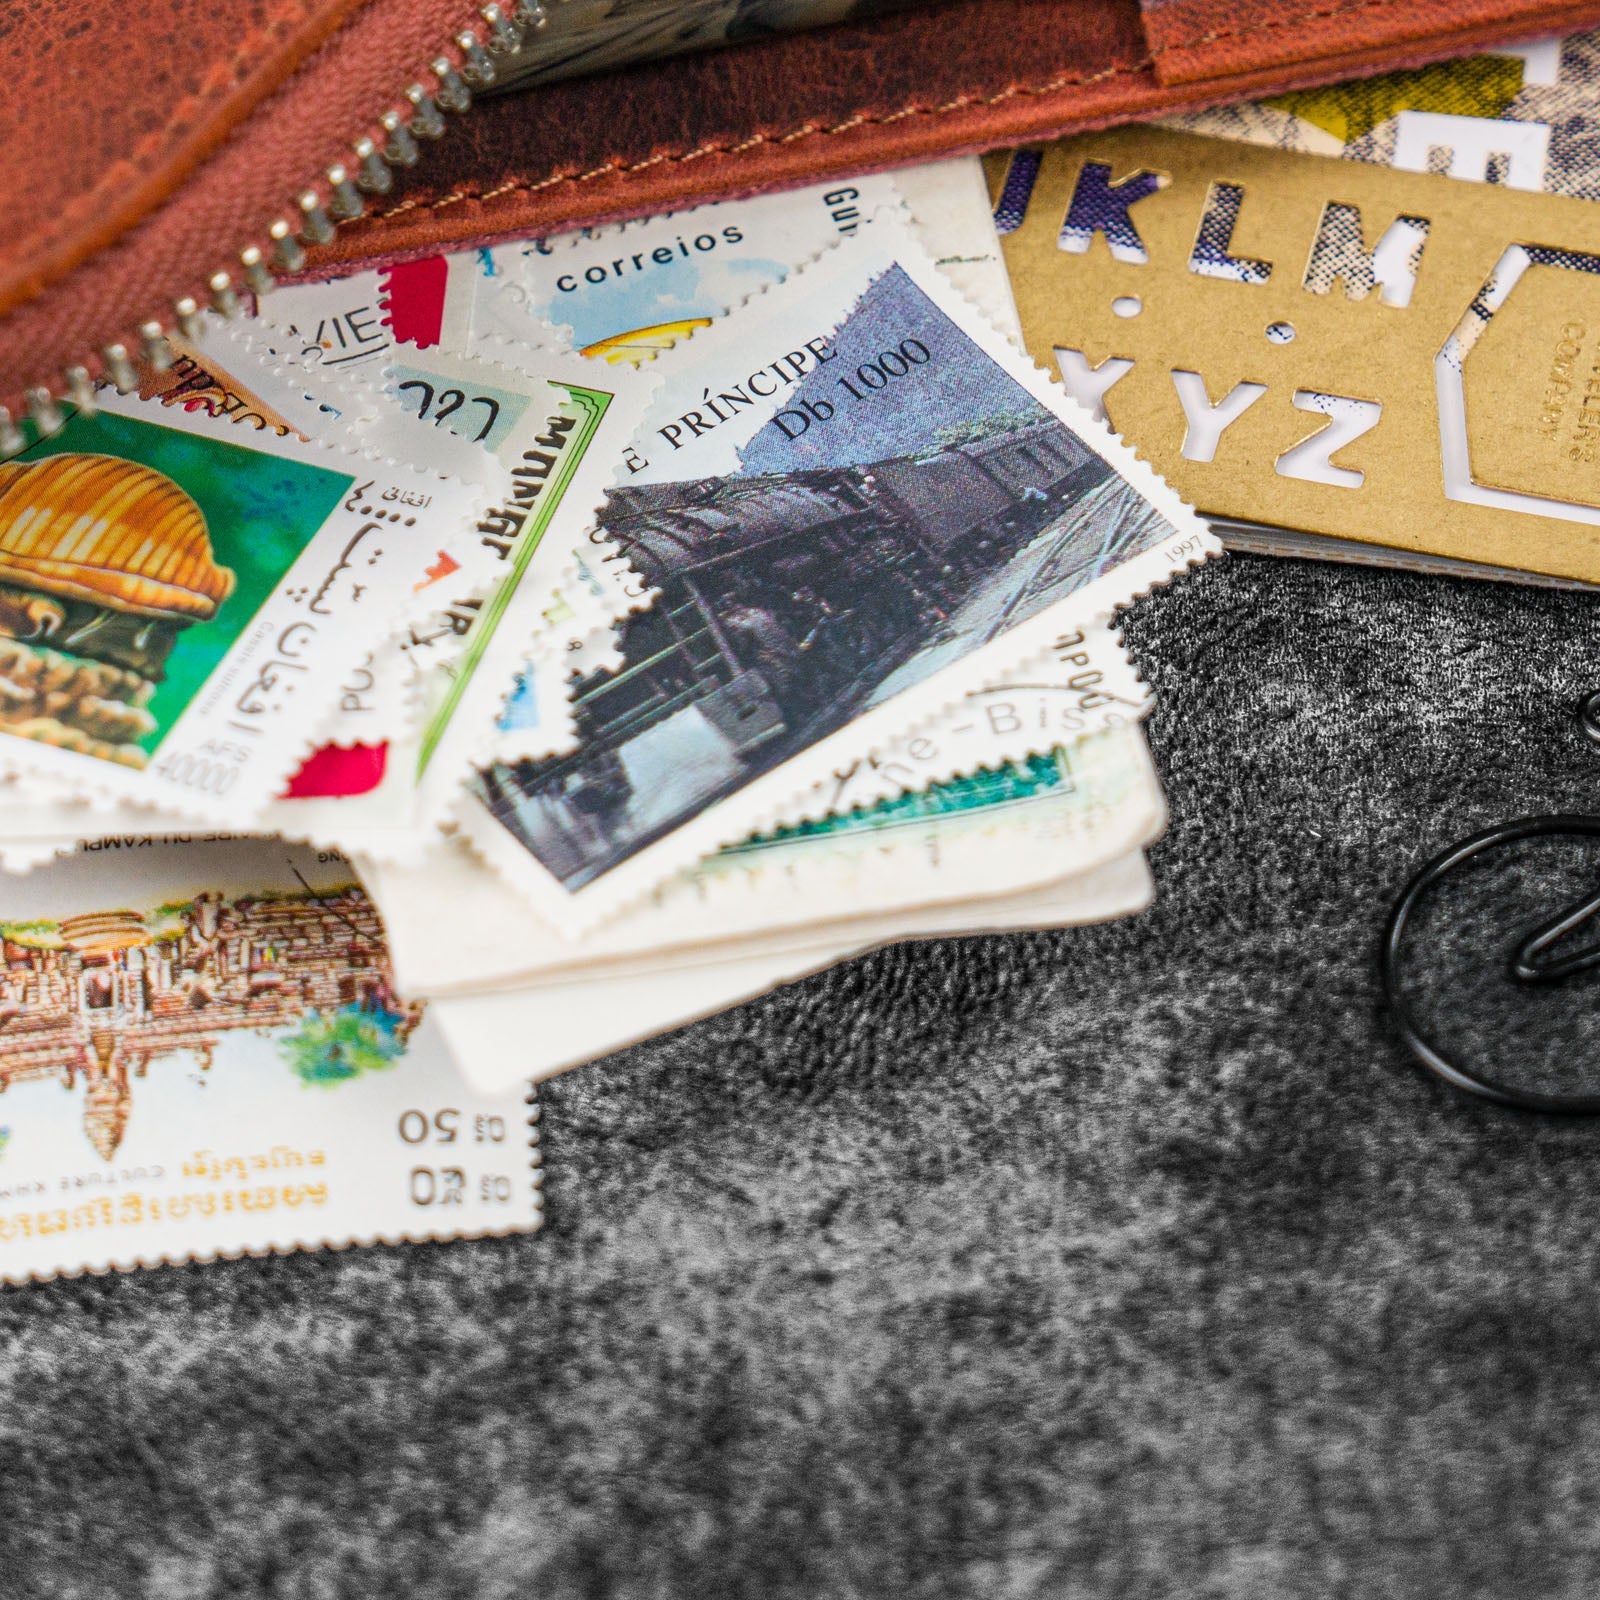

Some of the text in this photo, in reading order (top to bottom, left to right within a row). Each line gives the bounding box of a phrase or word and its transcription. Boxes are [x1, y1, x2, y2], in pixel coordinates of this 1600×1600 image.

[556, 225, 745, 293] correios
[656, 335, 839, 450] PRÍNCIPE
[770, 338, 933, 442] Db 1000
[1165, 535, 1202, 562] 1997
[400, 1108, 460, 1143] 50
[59, 1164, 164, 1191] CULTURE
